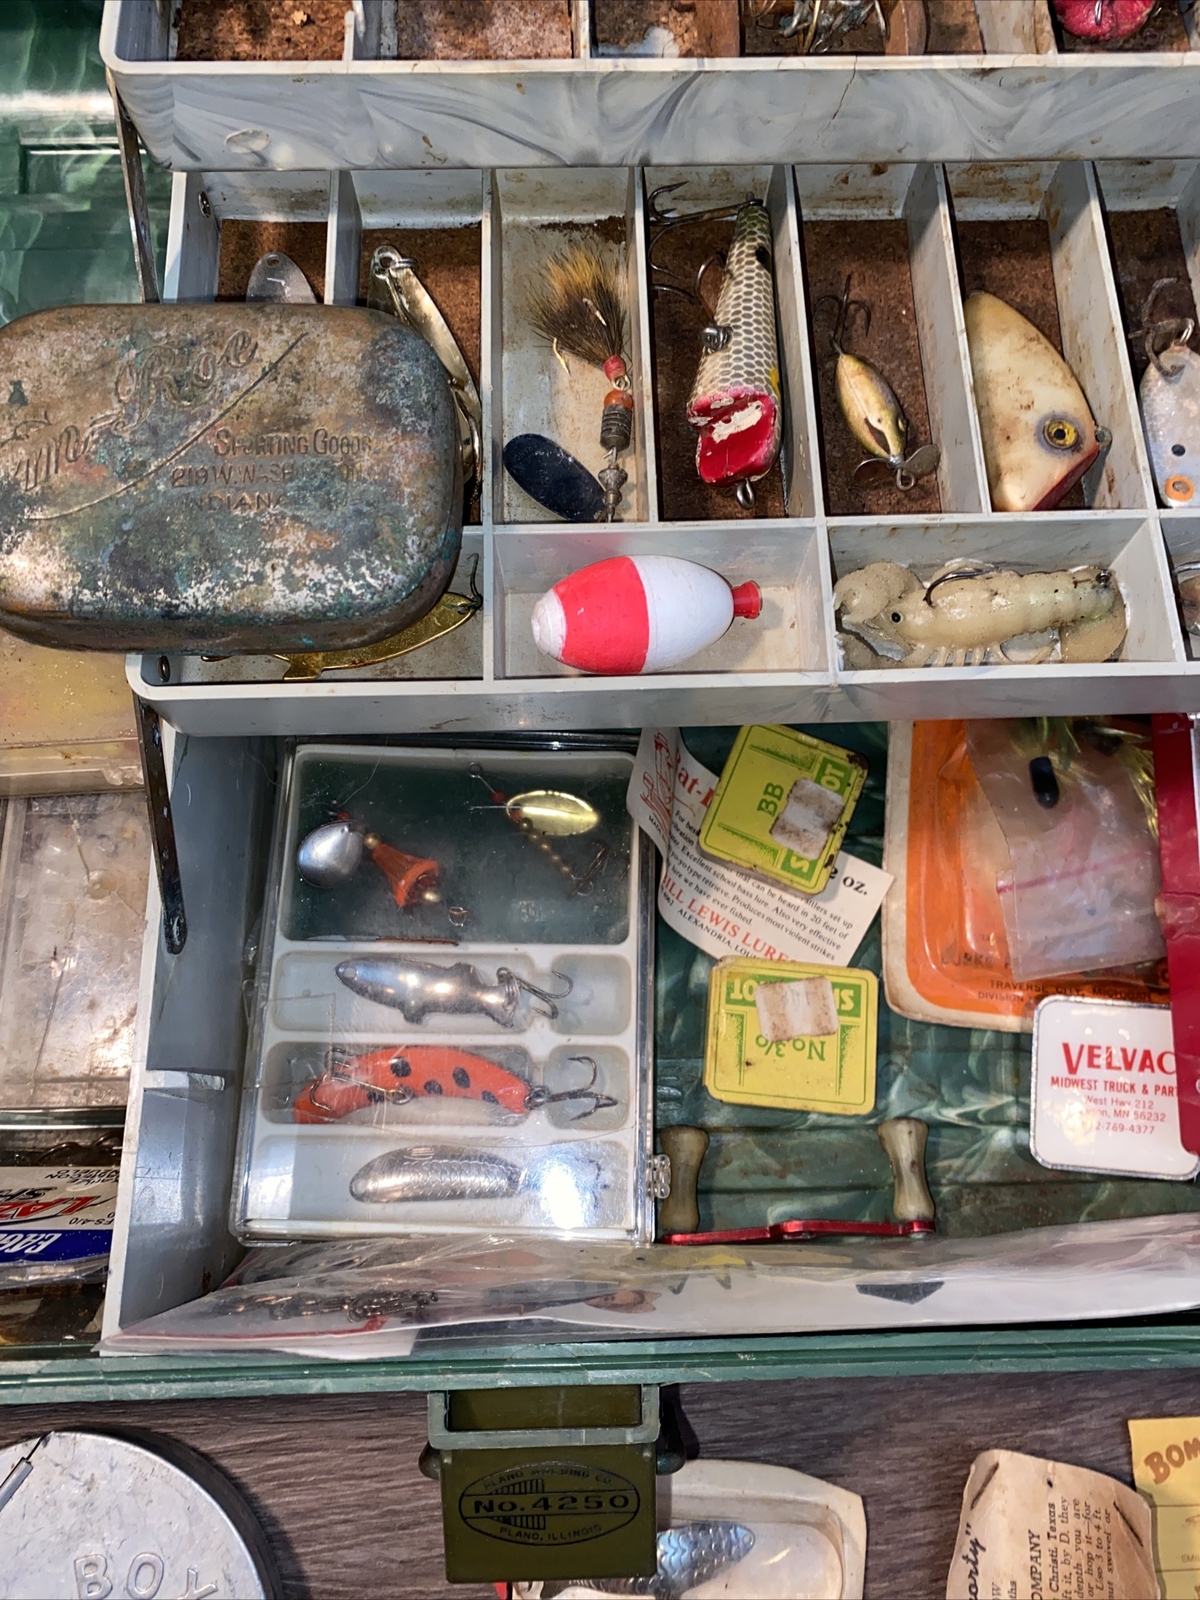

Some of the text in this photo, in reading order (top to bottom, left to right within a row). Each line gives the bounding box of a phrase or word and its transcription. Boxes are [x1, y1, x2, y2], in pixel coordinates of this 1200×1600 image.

[756, 781, 785, 818] BB
[674, 809, 687, 824] For
[841, 875, 868, 896] OZ.
[680, 844, 714, 874] Excellent
[712, 869, 738, 889] school
[737, 884, 754, 900] bass
[754, 894, 771, 911] lure.
[772, 906, 792, 922] Also
[791, 918, 809, 932] very
[808, 926, 842, 951] effective
[683, 877, 694, 888] we
[694, 884, 712, 900] have
[711, 897, 729, 911] ever
[729, 907, 753, 926] fished.
[701, 875, 731, 899] retrieve.
[731, 894, 766, 919] Produces
[765, 915, 784, 932] most
[784, 926, 811, 947] violent
[810, 942, 836, 962] strikes
[751, 880, 766, 893] can
[766, 887, 777, 899] be
[777, 895, 800, 913] heard
[800, 907, 809, 918] in
[810, 913, 822, 925] 20
[822, 919, 837, 935] feet
[838, 931, 850, 941] of
[829, 912, 842, 923] set
[842, 919, 854, 930] up
[677, 907, 733, 950] ALEXANDRIA,
[686, 897, 741, 939] LEWIS
[741, 931, 797, 963] LURE
[1061, 1042, 1178, 1076] VELVAC
[1050, 1075, 1098, 1092] MIDWEST
[1103, 1080, 1137, 1095] TRUCK
[1141, 1084, 1149, 1096] &
[1113, 1109, 1130, 1119] MN
[1133, 1110, 1166, 1123] 56232
[1134, 1099, 1155, 1111] 212
[0, 1232, 62, 1254] EAG
[1057, 1496, 1071, 1524] they
[1104, 1508, 1112, 1524] or
[499, 1523, 602, 1542] PLANO, ILLINOIS
[1047, 1502, 1058, 1541] Texas
[1094, 1523, 1103, 1533] 4
[1059, 1530, 1071, 1545] D.
[1072, 1498, 1084, 1599] depth you are
[1094, 1537, 1104, 1551] to
[1060, 1549, 1073, 1567] by
[1095, 1553, 1104, 1562] 3
[1103, 1531, 1114, 1574] swivel
[1084, 1552, 1095, 1576] hop
[1086, 1581, 1094, 1598] or
[1095, 1568, 1105, 1592] Use
